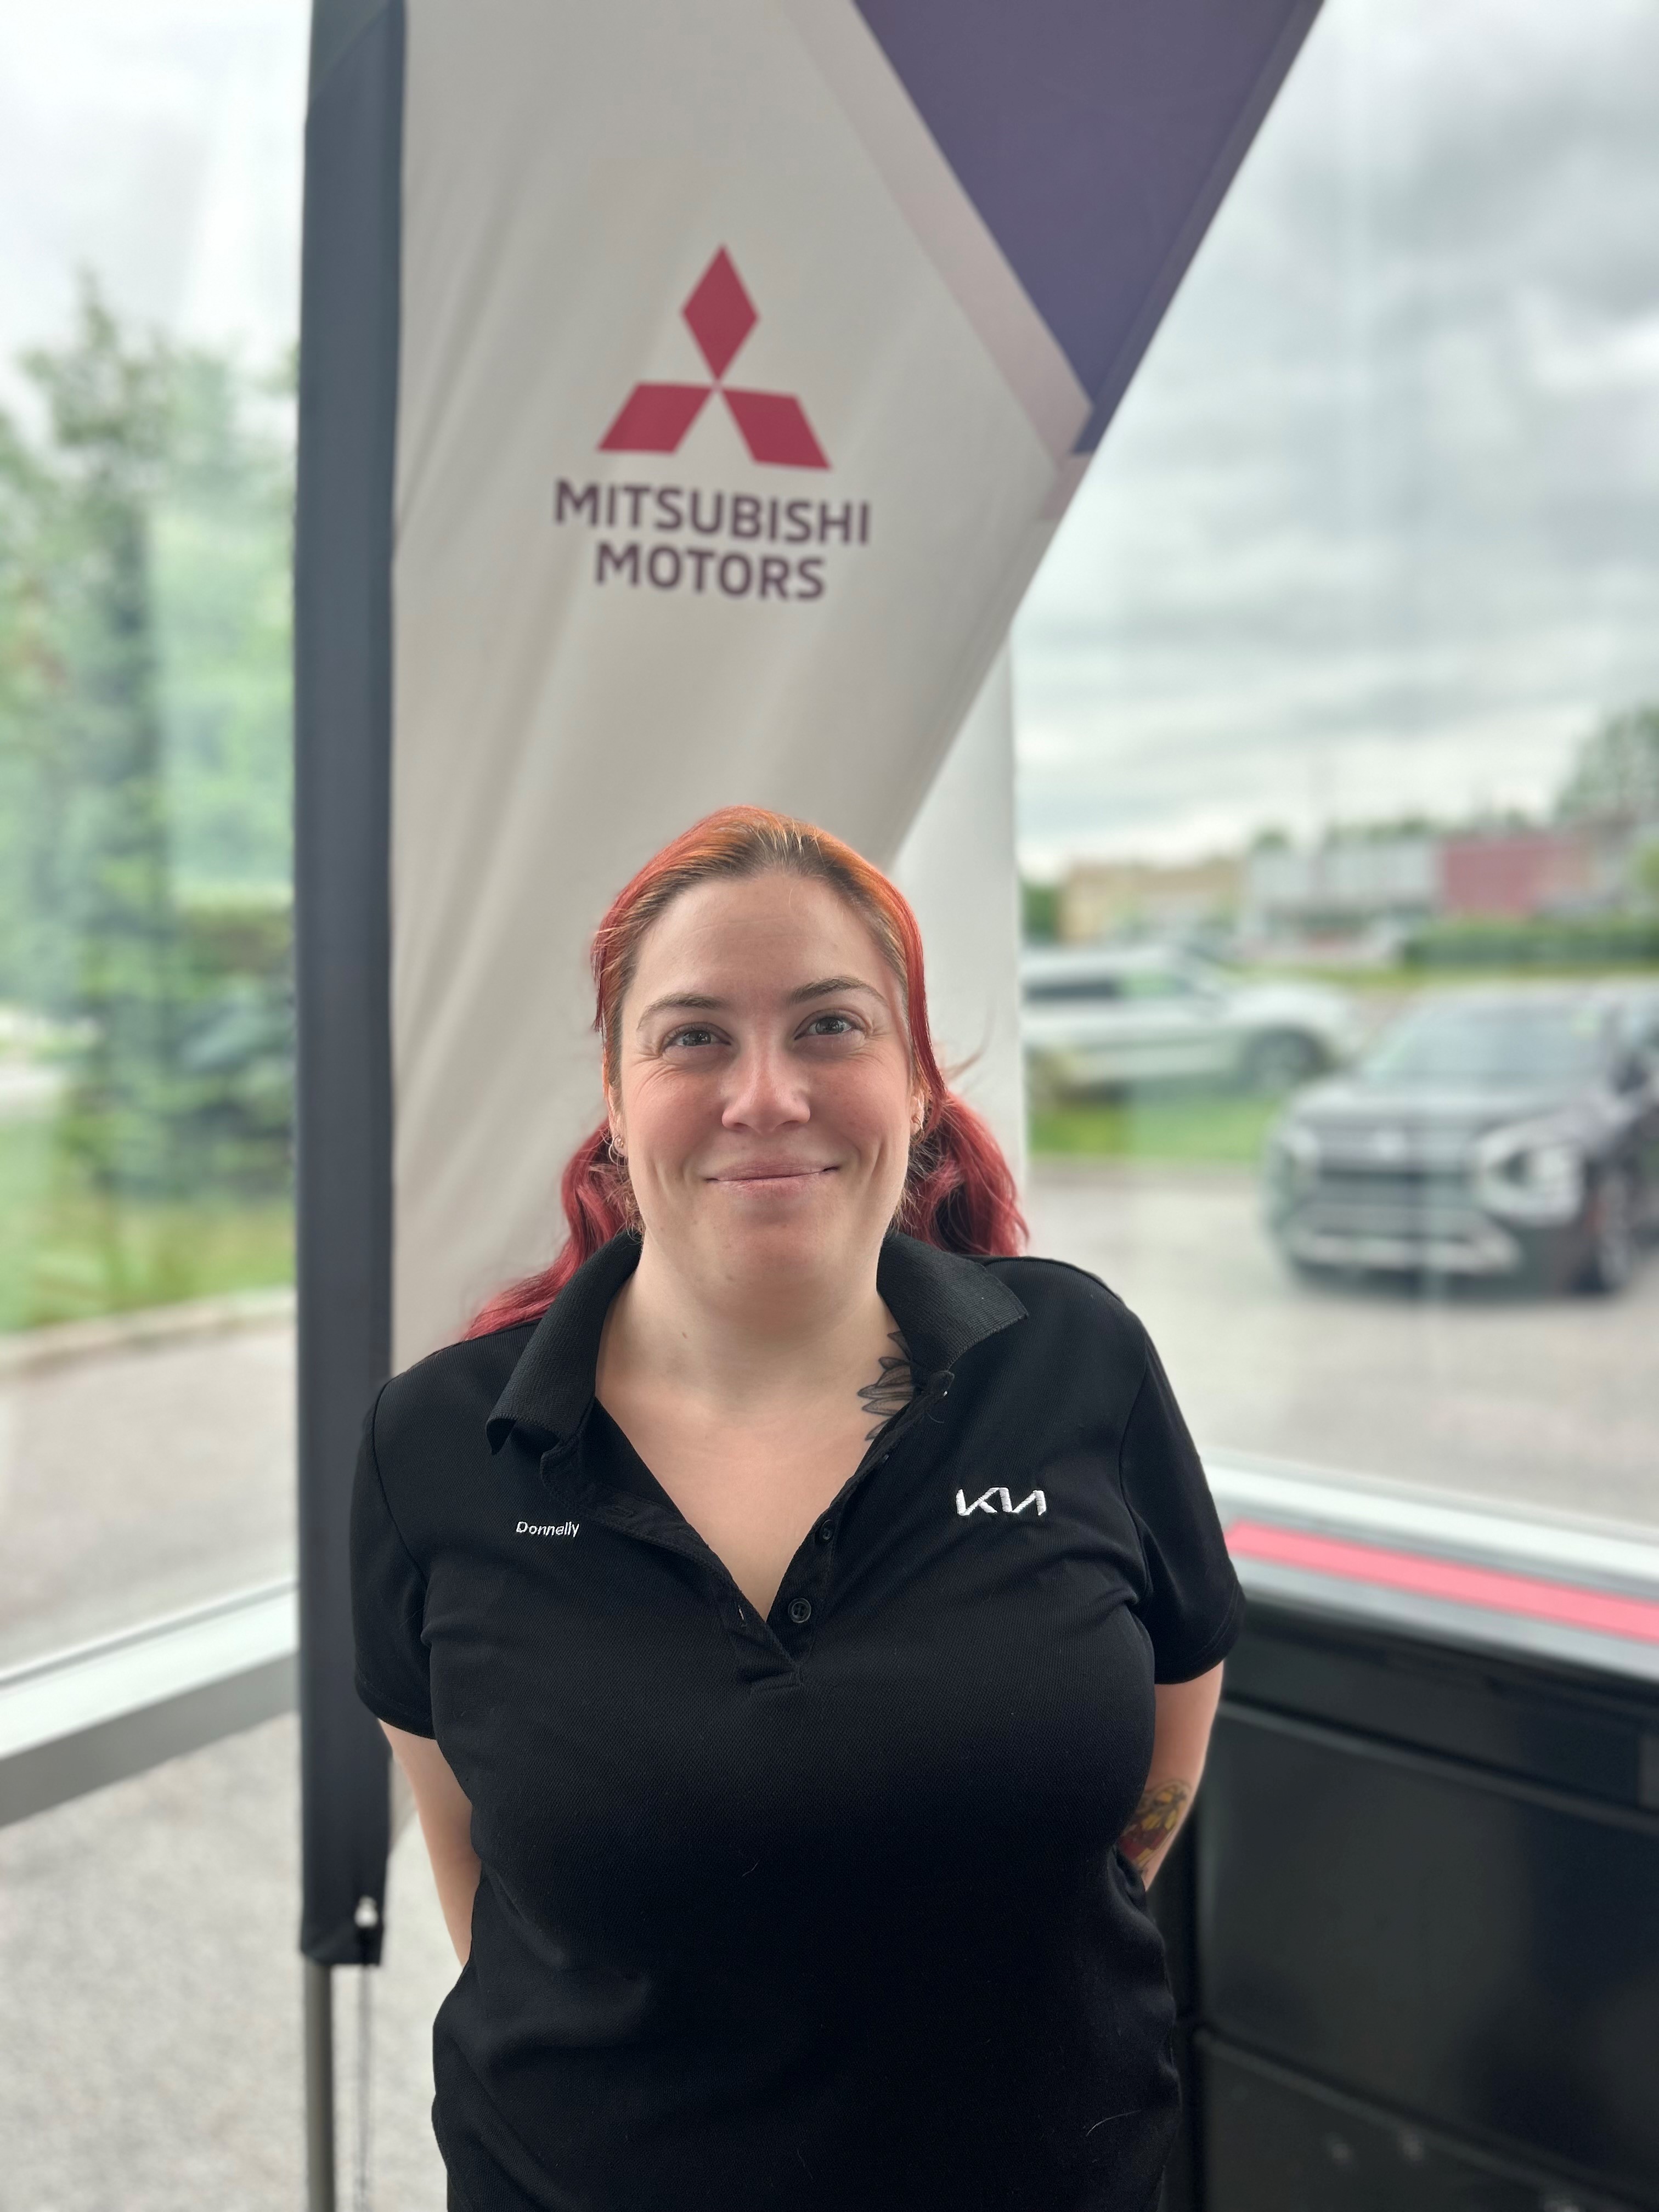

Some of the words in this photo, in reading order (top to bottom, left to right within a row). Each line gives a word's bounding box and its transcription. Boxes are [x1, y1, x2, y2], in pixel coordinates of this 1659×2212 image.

[554, 478, 870, 545] MITSUBISHI
[595, 541, 826, 600] MOTORS
[956, 1487, 1047, 1516] KIA
[516, 1521, 579, 1538] Donnelly
